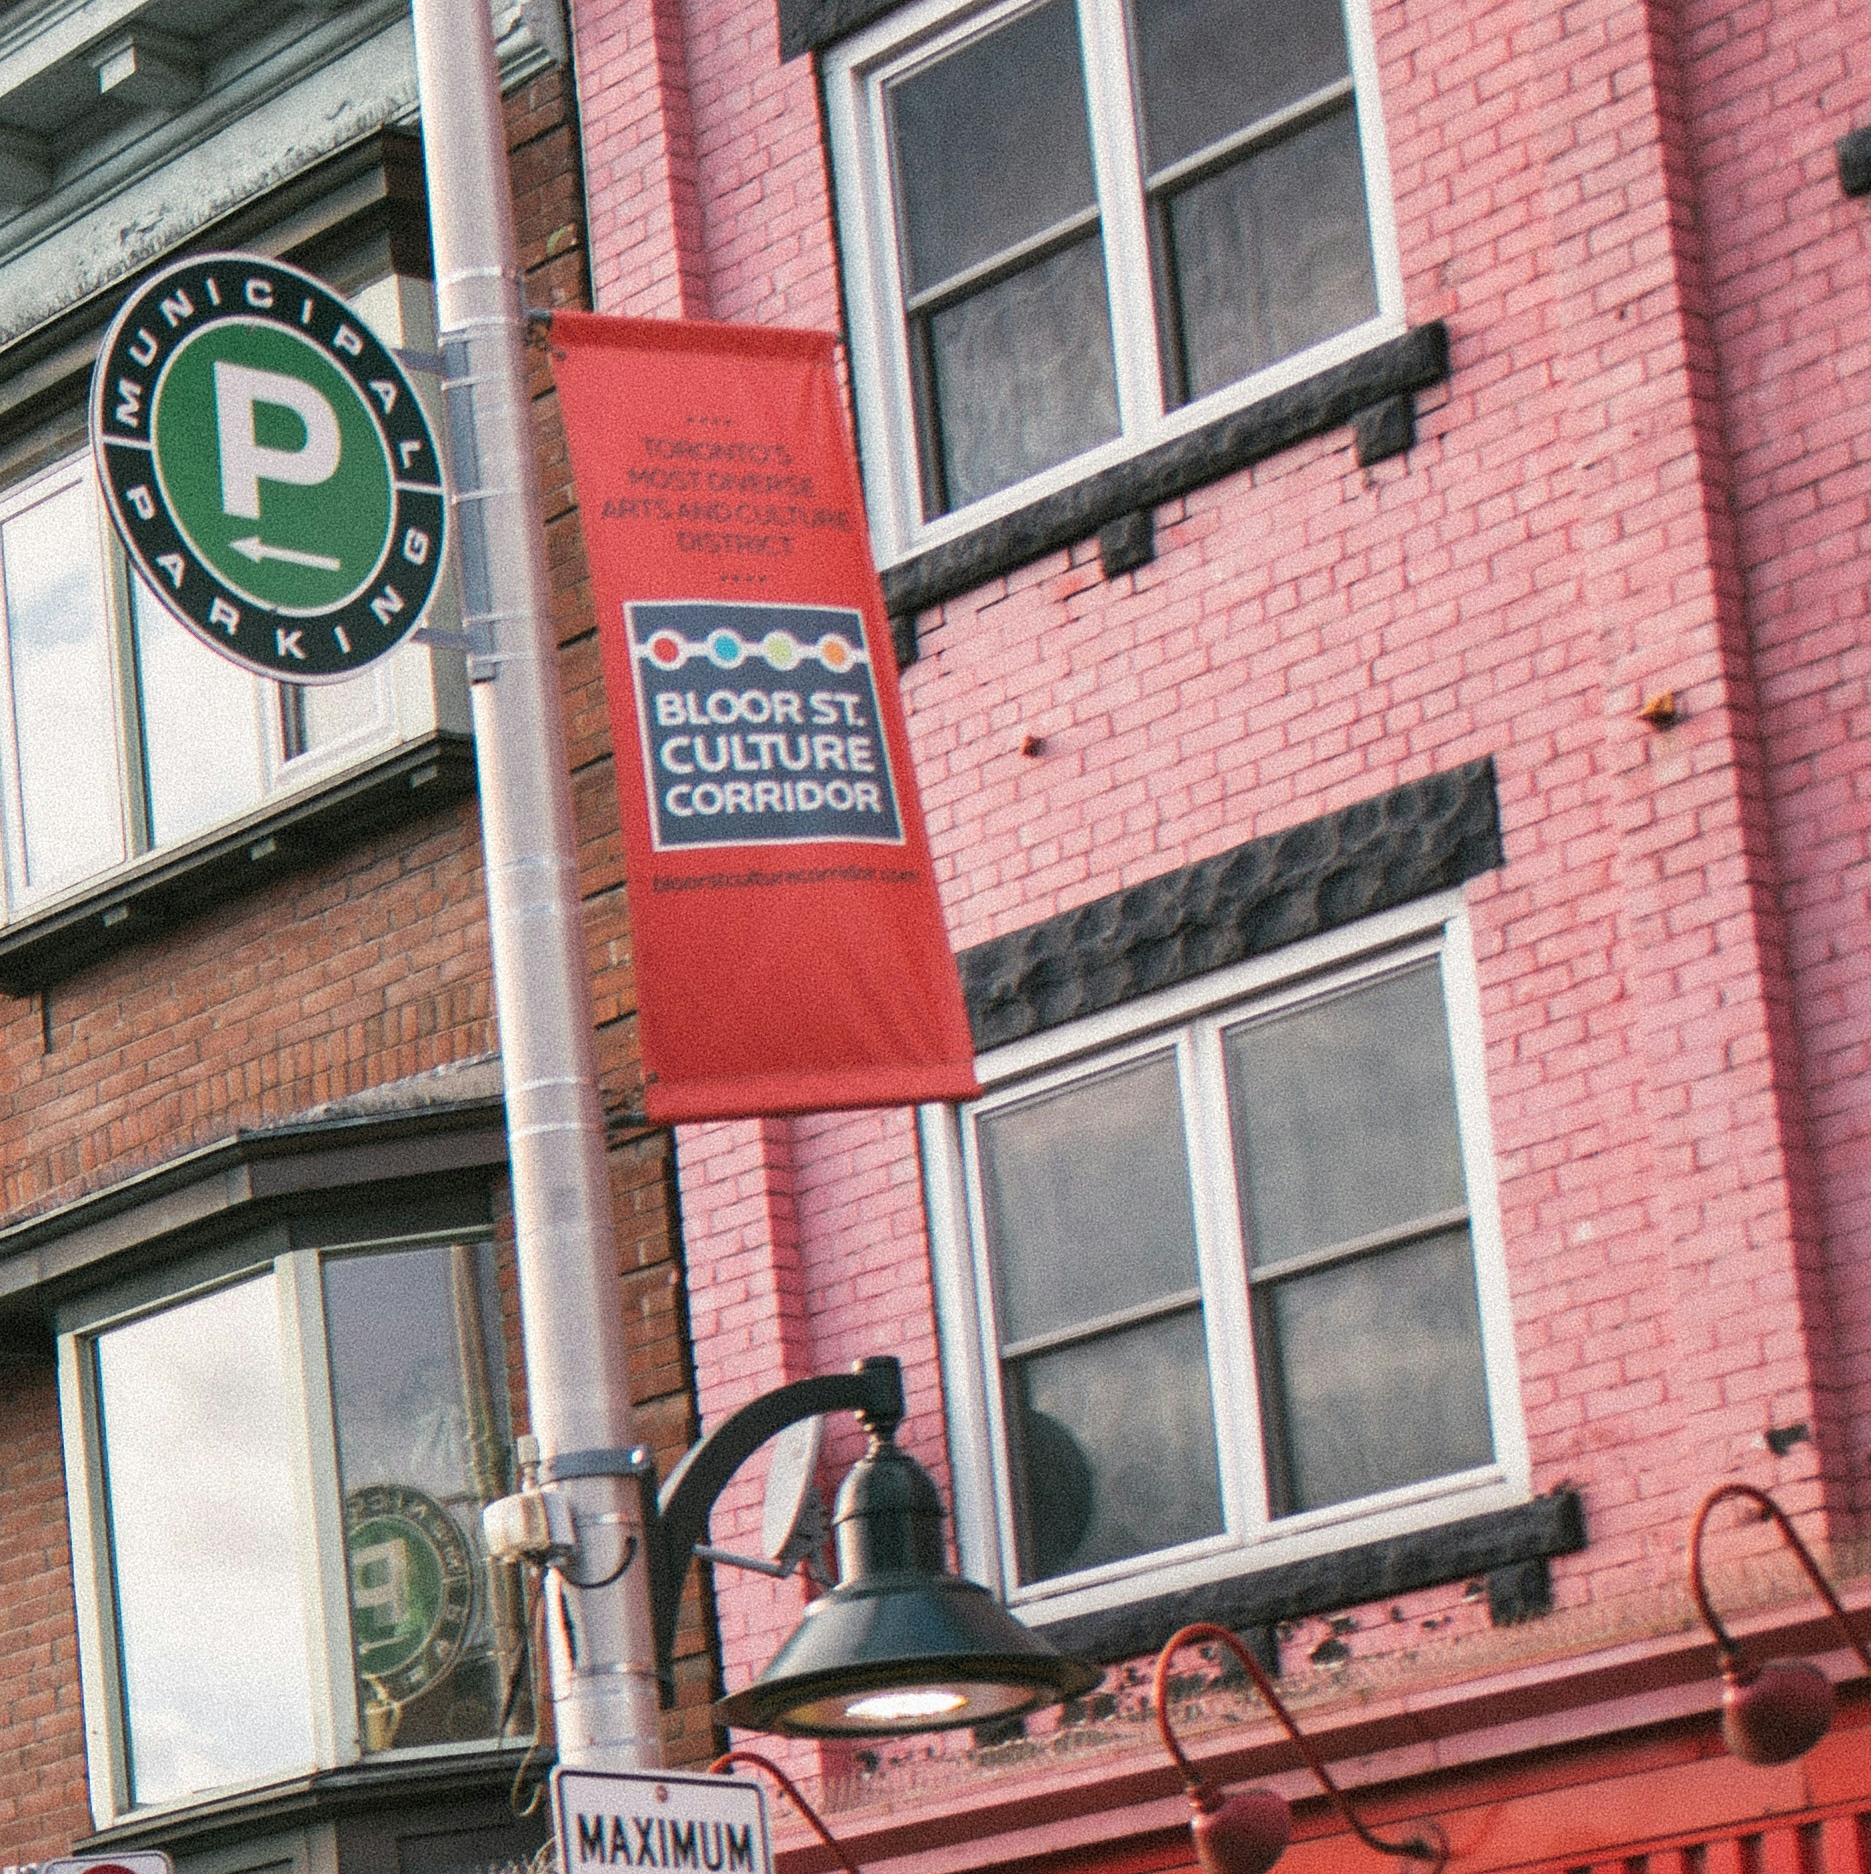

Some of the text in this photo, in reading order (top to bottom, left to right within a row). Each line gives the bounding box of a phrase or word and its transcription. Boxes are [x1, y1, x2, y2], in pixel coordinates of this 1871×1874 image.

[116, 277, 426, 470] MUNICIPAL
[212, 359, 342, 520] P
[643, 436, 794, 466] TORONTO'S
[627, 467, 817, 498] MOST DIVERSE
[601, 497, 852, 534] ARTS AND CULTURE
[675, 530, 794, 557] DISTRICT
[126, 483, 430, 662] PARKING
[656, 688, 866, 727] BLOOR ST.
[660, 732, 877, 775] CULTURE
[664, 779, 883, 817] CORRIDOR
[577, 1813, 755, 1874] MAXIMUM
